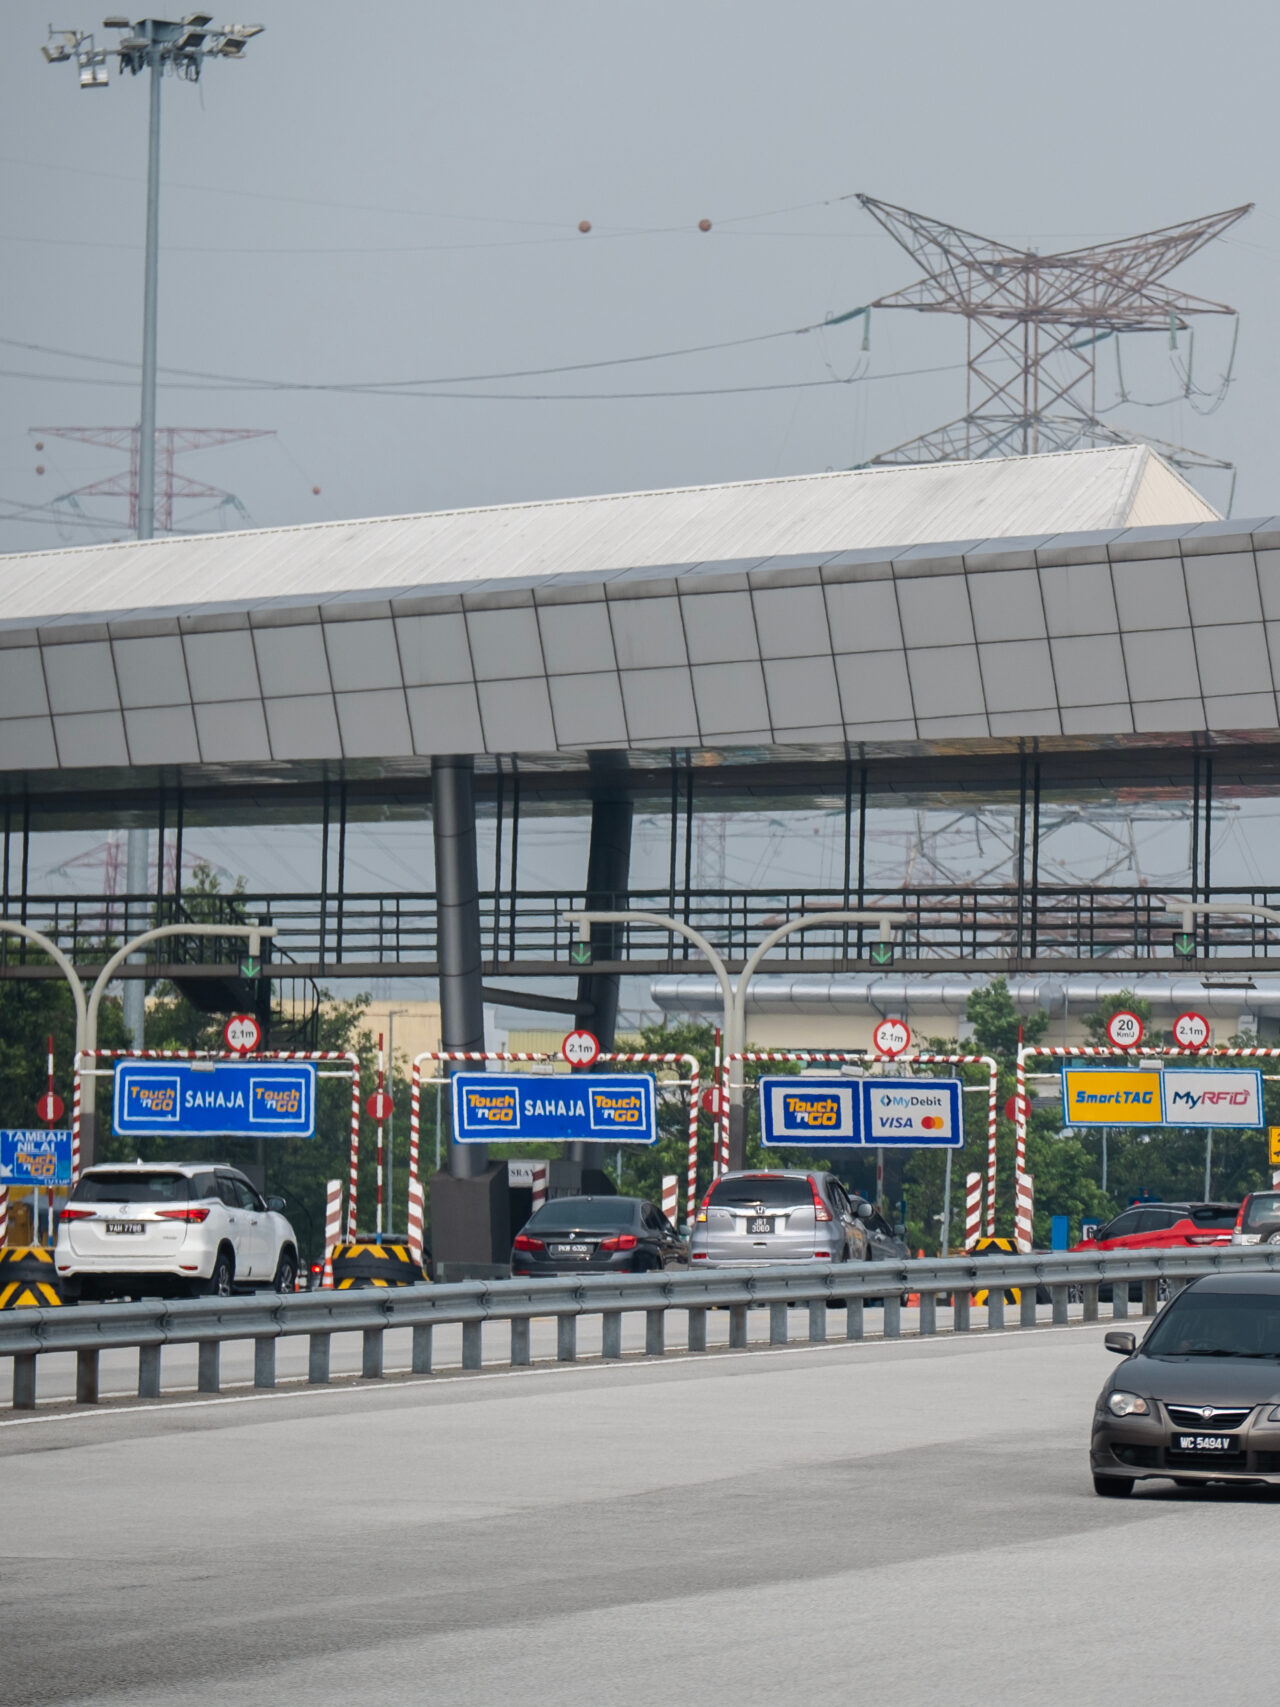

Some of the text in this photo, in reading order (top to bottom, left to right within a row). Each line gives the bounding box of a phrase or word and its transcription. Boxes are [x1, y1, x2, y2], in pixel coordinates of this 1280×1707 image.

[1118, 1019, 1134, 1031] 20
[1180, 1026, 1203, 1036] 2.1m
[231, 1030, 254, 1039] 2.1m
[881, 1031, 904, 1043] 2.1m
[569, 1044, 593, 1053] 2.1m
[130, 1086, 175, 1100] Touch
[185, 1090, 245, 1108] SAHAJA
[255, 1087, 300, 1101] Touch
[468, 1094, 514, 1108] Touch
[594, 1095, 640, 1109] Touch
[786, 1097, 838, 1112] Touch
[893, 1095, 942, 1108] MyDebit
[525, 1100, 585, 1117] SAHAJA
[880, 1116, 913, 1129] VISA
[6, 1130, 67, 1142] TAMBAH
[17, 1141, 55, 1152] NILAI
[1180, 1436, 1195, 1448] WC
